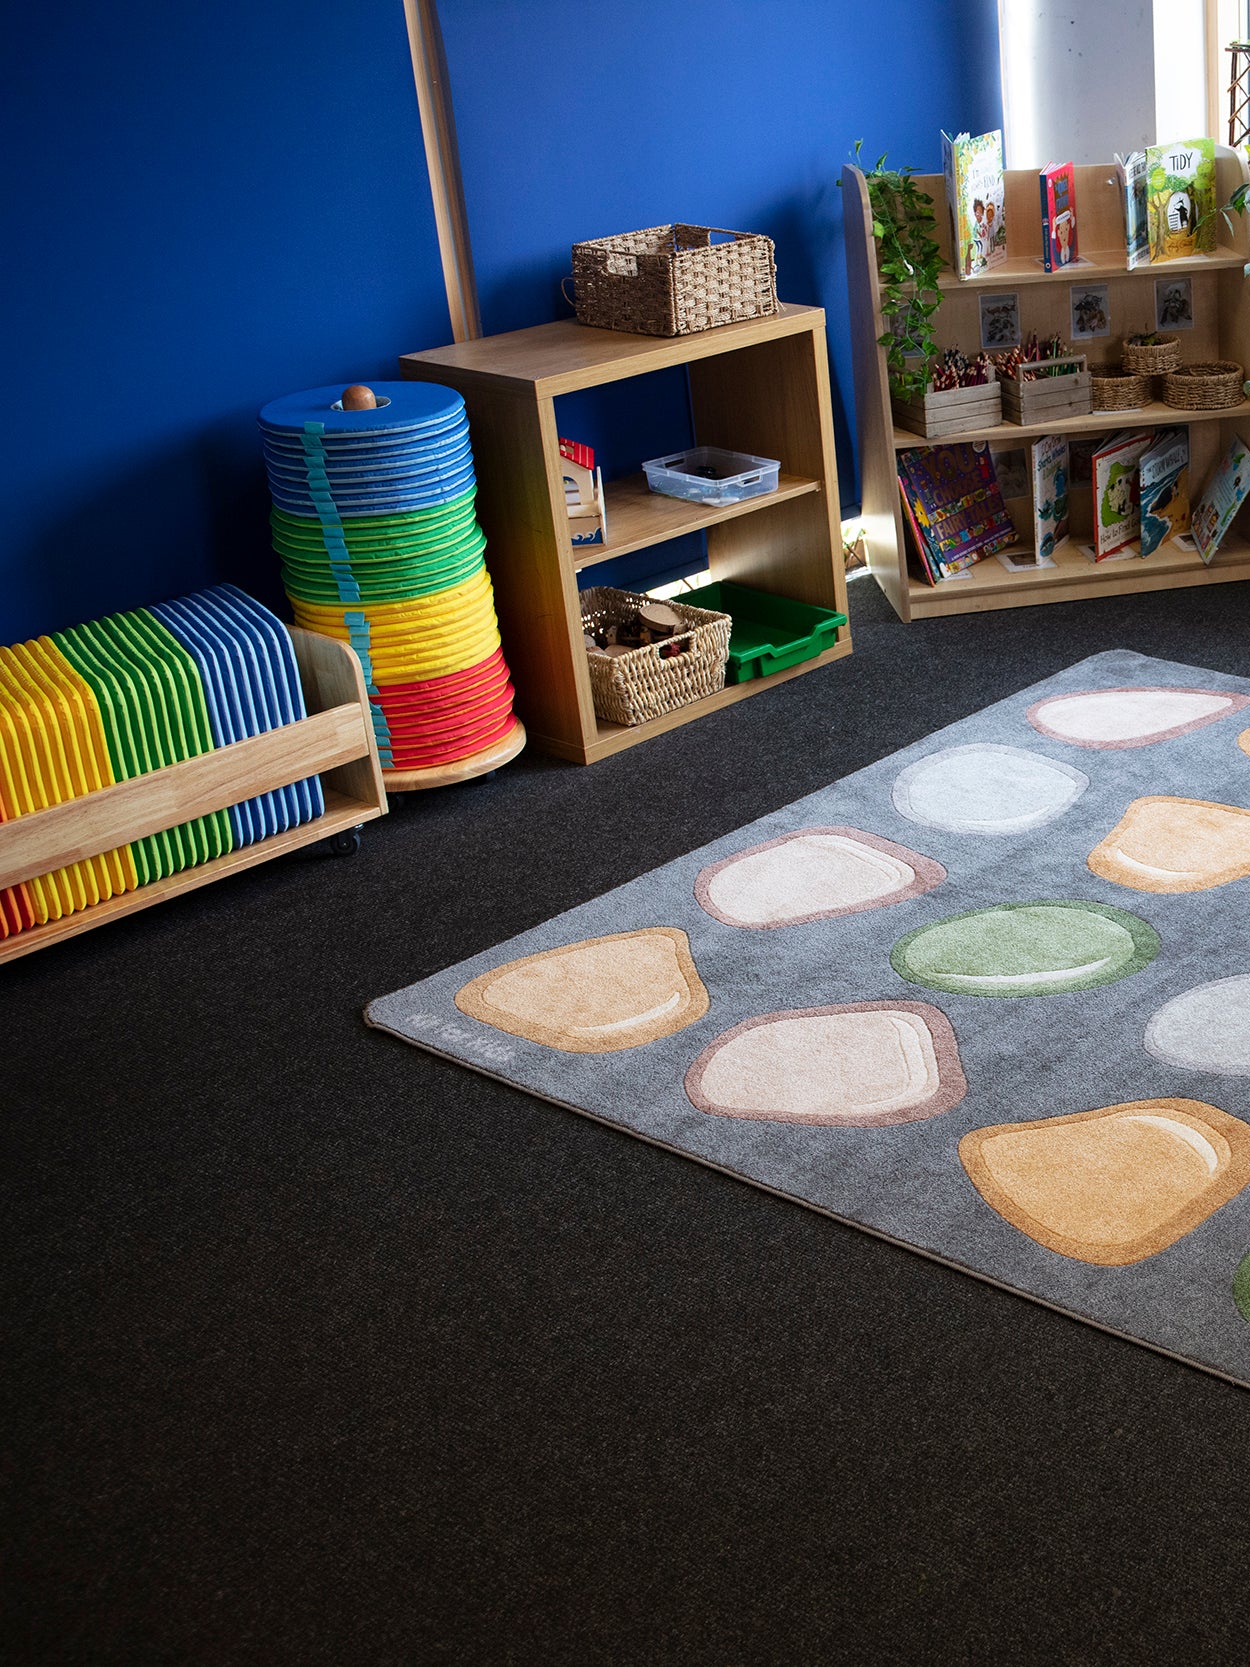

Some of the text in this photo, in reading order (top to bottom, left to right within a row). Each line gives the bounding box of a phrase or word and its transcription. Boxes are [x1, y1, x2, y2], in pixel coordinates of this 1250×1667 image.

[1169, 152, 1193, 171] TIDY
[922, 446, 976, 484] YOU
[936, 496, 1005, 540] FAIRY TALES
